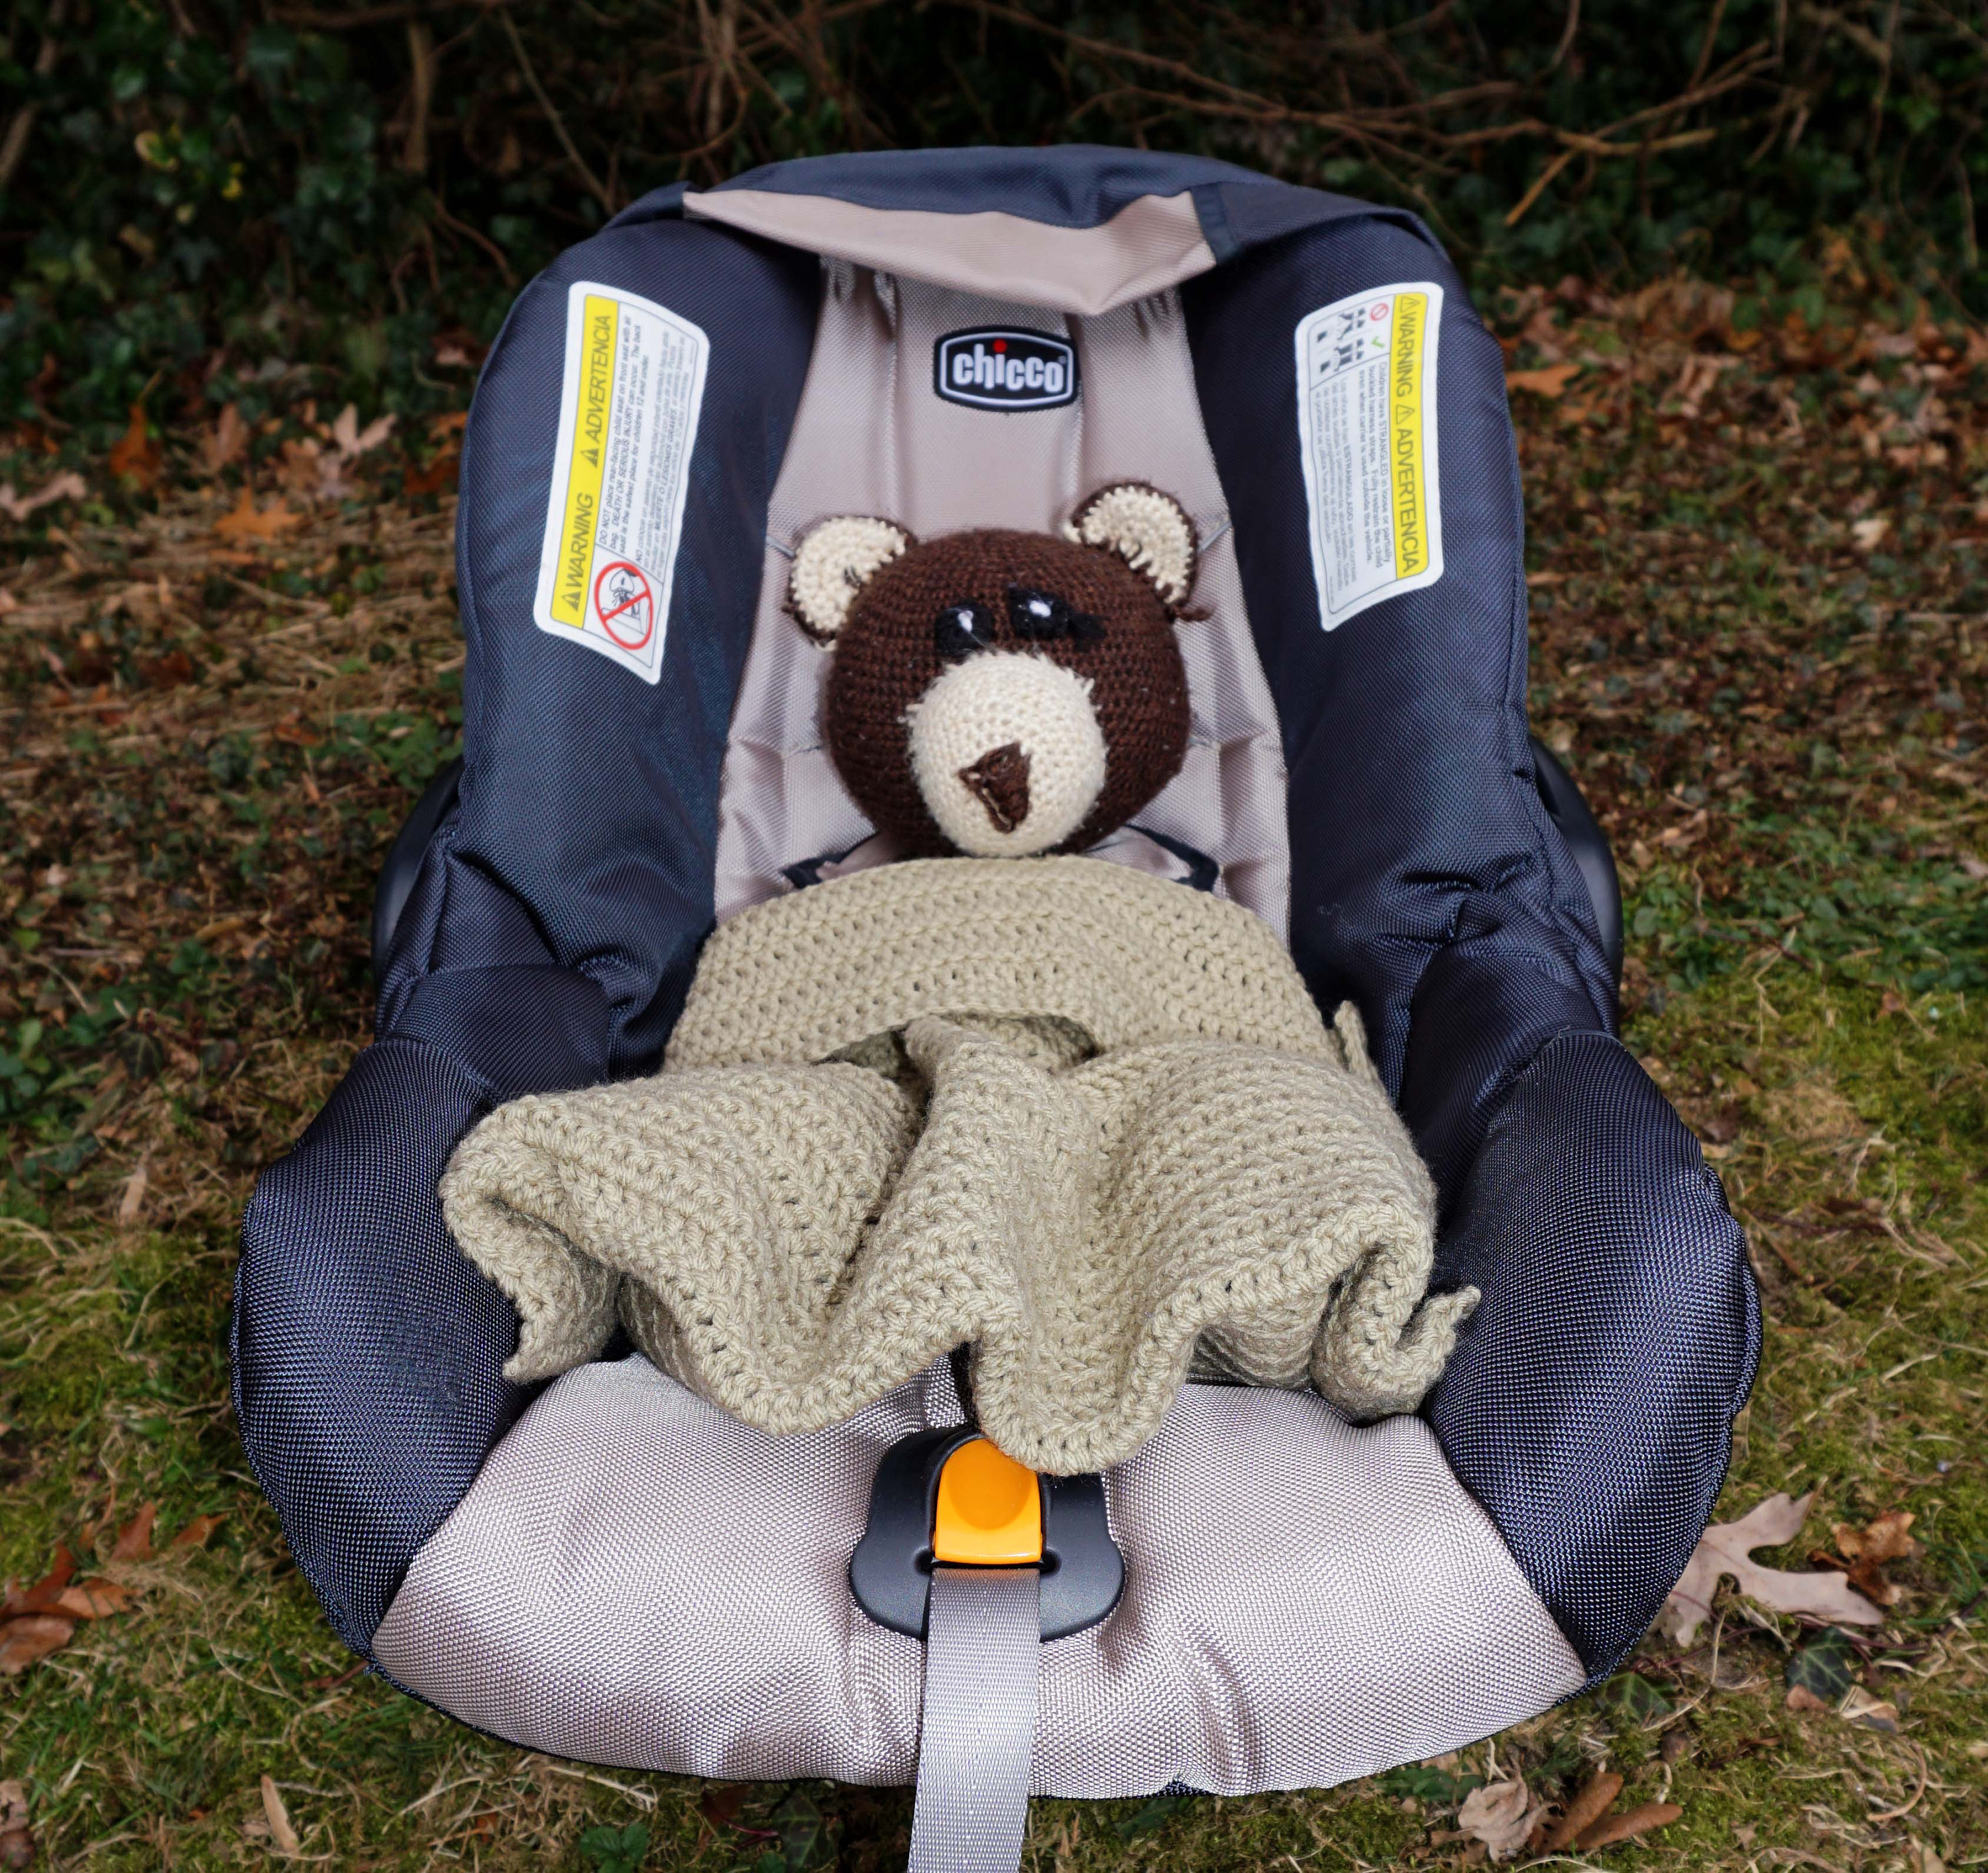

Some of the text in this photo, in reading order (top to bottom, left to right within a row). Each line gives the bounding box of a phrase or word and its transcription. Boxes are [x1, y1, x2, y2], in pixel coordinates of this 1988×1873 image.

[631, 345, 639, 359] The
[953, 339, 1064, 393] chicco
[619, 363, 628, 382] front
[619, 384, 625, 394] on
[614, 414, 622, 435] child
[623, 406, 633, 437] INJURY
[565, 315, 611, 587] WARNING ADVERTENCIA
[1379, 420, 1388, 476] STRANGLED
[1397, 312, 1419, 573] WARNING ADVERTENCIA
[609, 437, 621, 482] rear-facing
[618, 439, 630, 478] SERIOUS
[625, 482, 634, 508] safest
[634, 410, 642, 443] children
[605, 484, 614, 508] place
[617, 480, 624, 493] OR
[612, 496, 623, 526] DEATH
[1383, 515, 1389, 524] or
[599, 530, 607, 545] DO
[1383, 528, 1392, 562] partially
